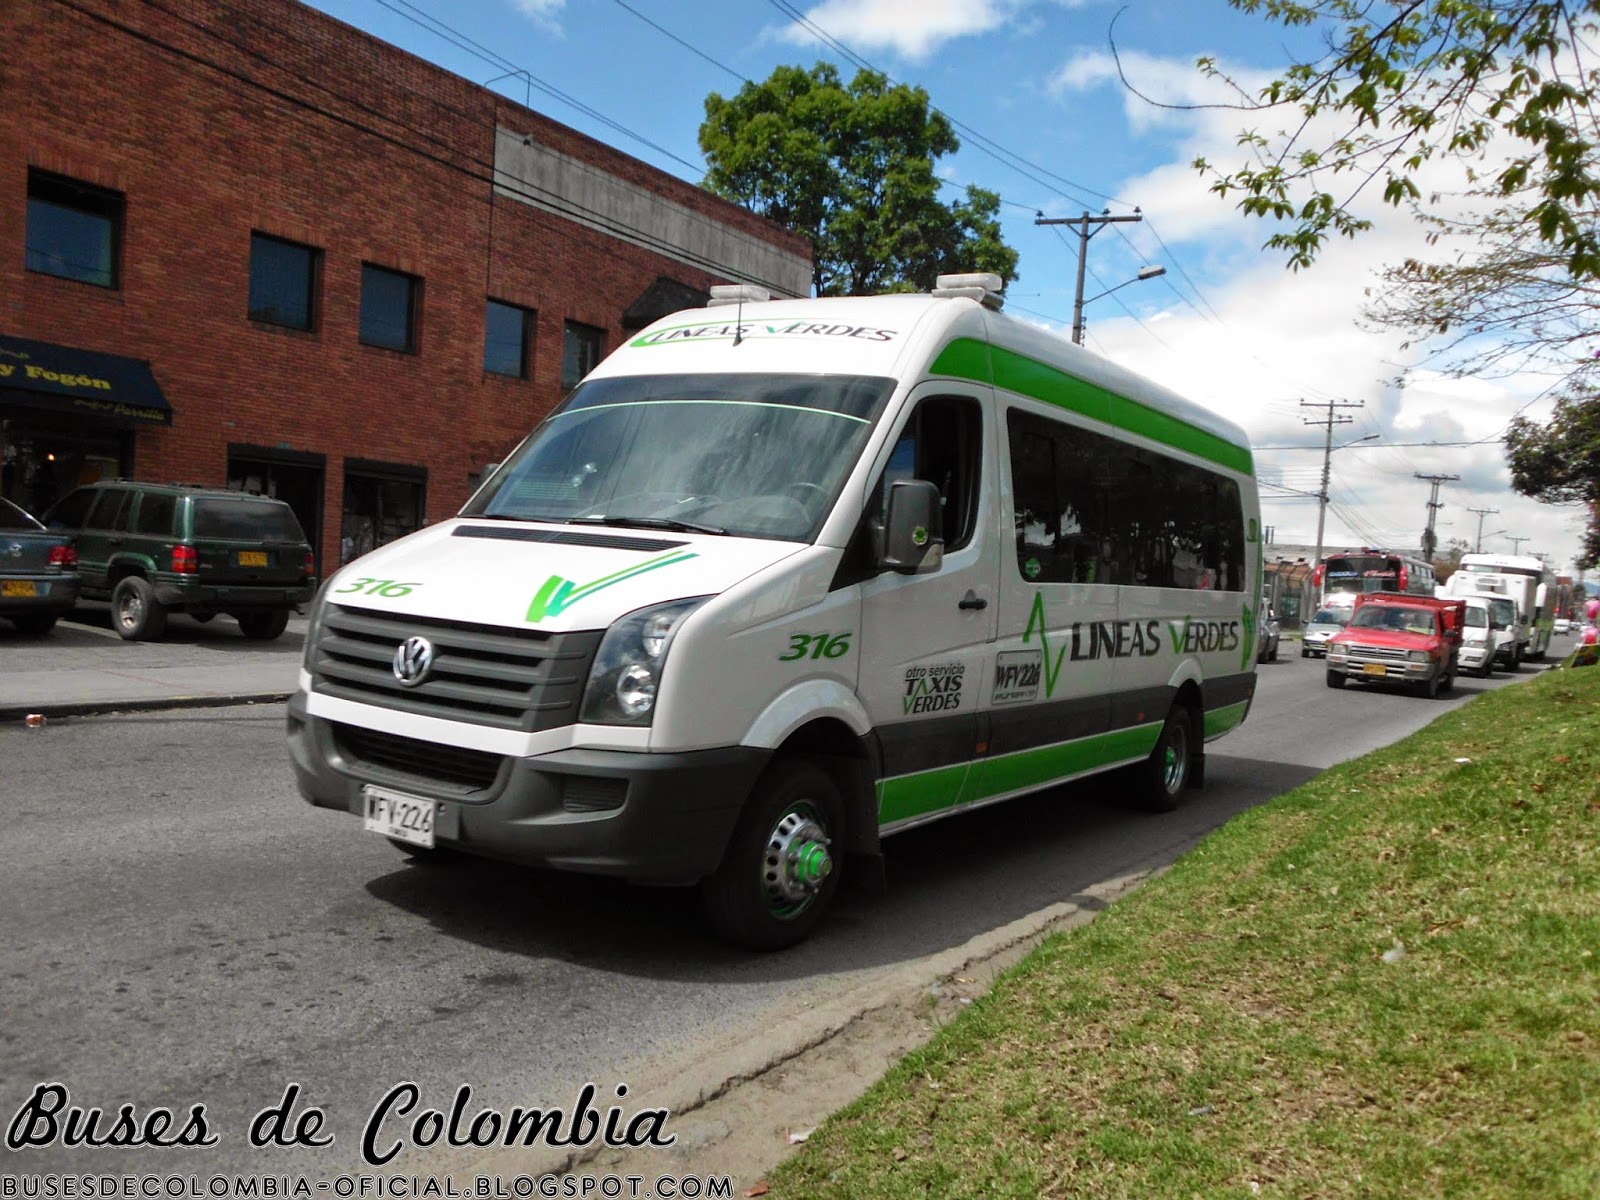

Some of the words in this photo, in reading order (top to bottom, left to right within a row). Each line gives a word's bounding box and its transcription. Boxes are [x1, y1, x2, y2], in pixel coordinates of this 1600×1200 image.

[649, 323, 755, 344] LINEAS
[765, 320, 898, 342] VERDES
[24, 364, 112, 390] Fogón
[335, 578, 423, 598] 316
[779, 633, 853, 661] 316
[1070, 620, 1161, 661] LINEAS
[1168, 615, 1239, 654] VERDES
[905, 666, 926, 679] otro
[928, 663, 966, 677] servicio
[904, 675, 963, 697] TAXIS
[902, 692, 961, 716] VERDES
